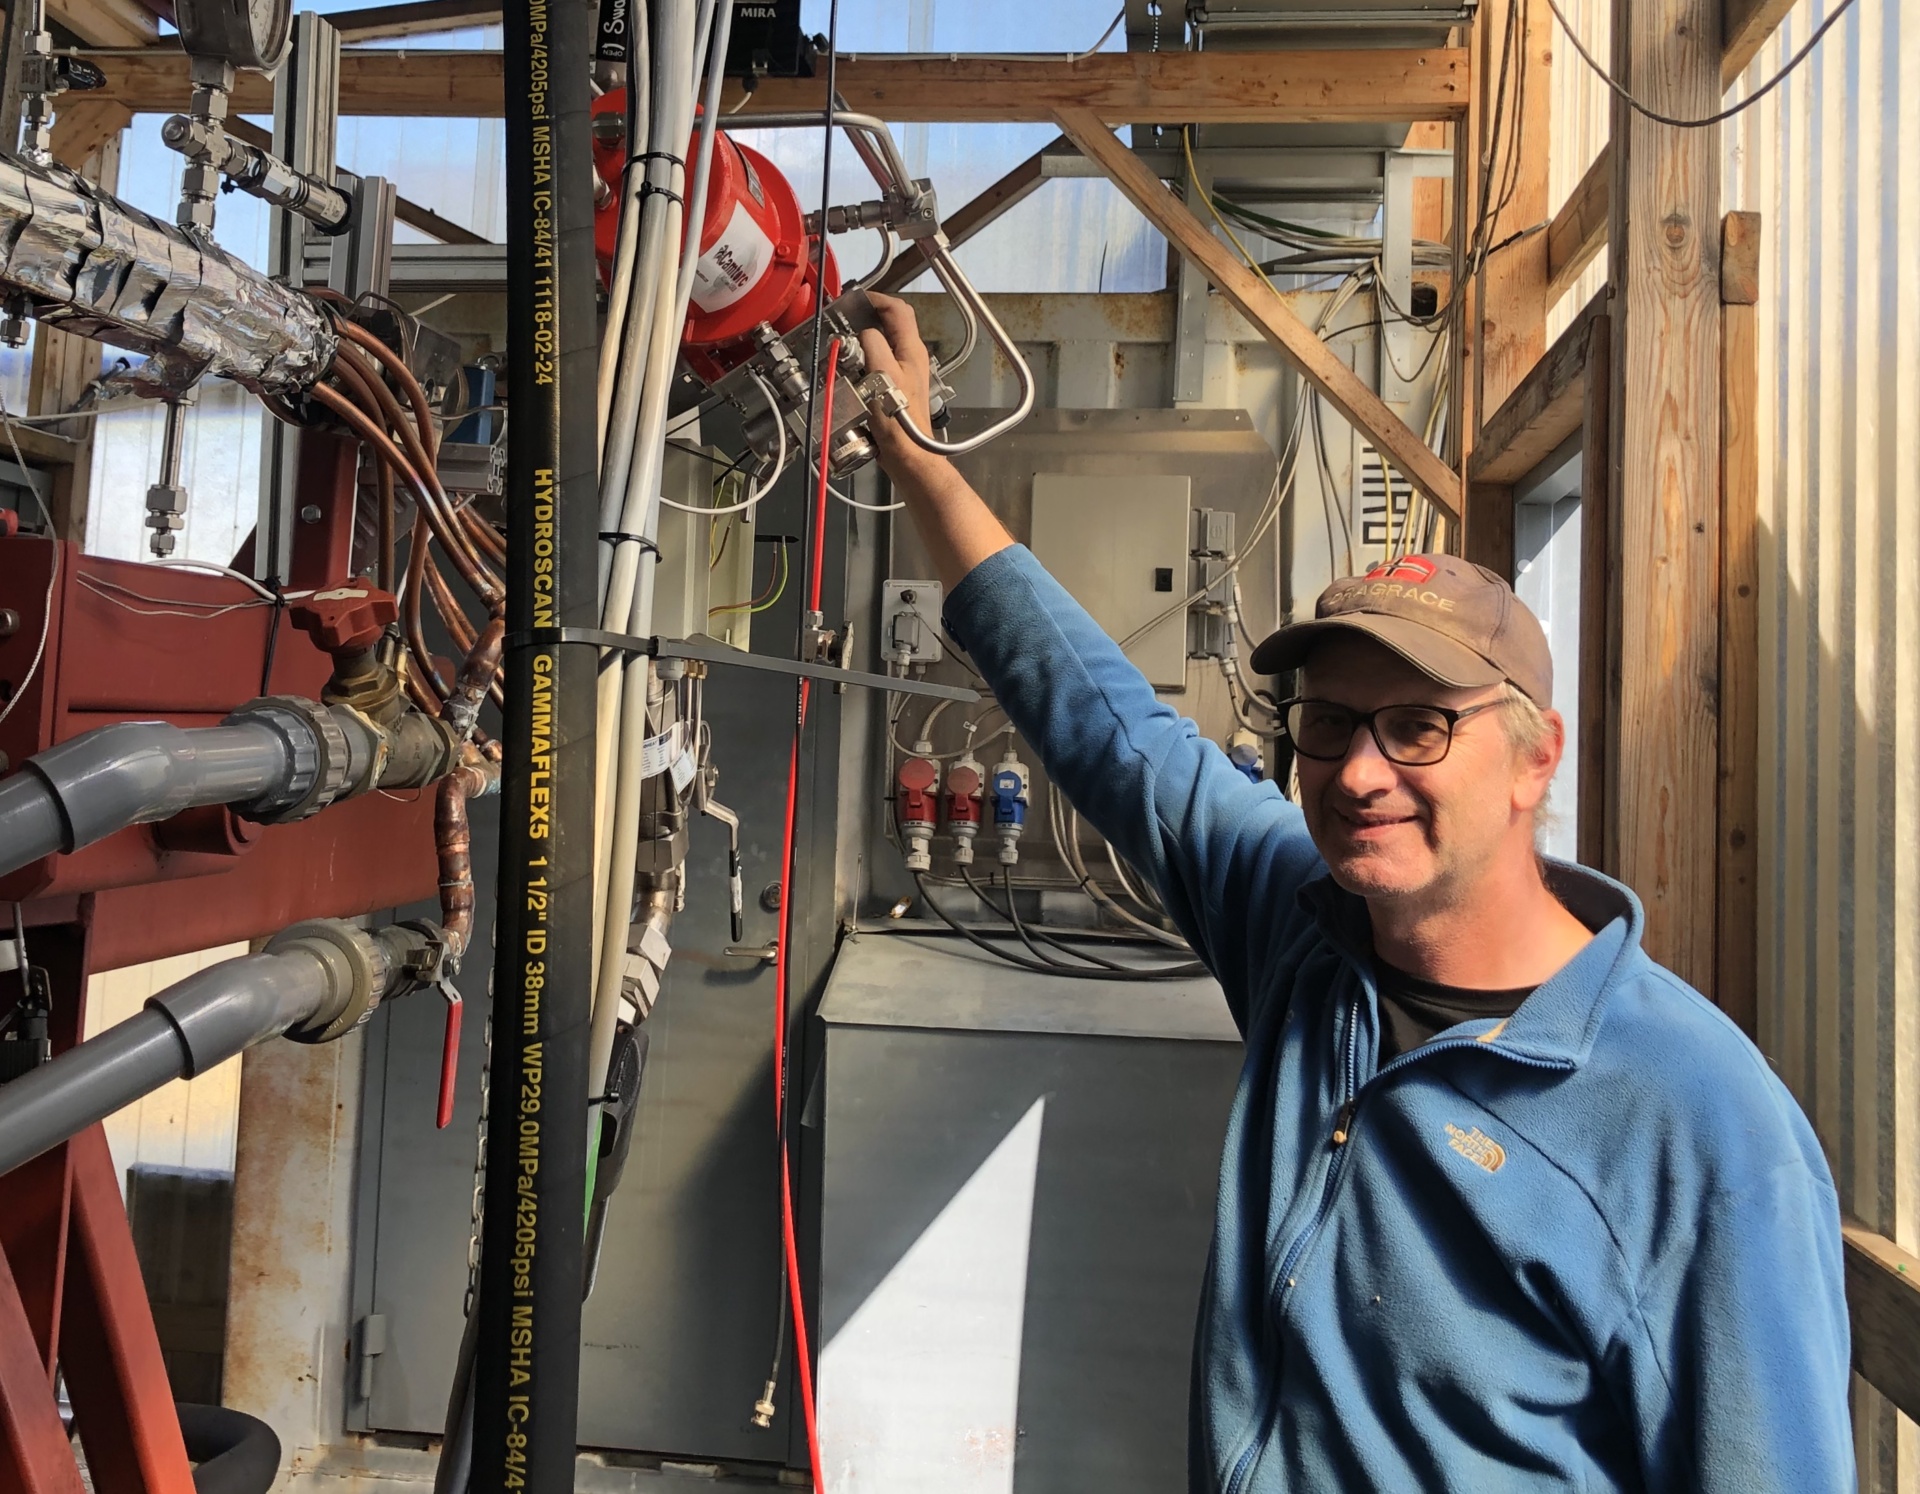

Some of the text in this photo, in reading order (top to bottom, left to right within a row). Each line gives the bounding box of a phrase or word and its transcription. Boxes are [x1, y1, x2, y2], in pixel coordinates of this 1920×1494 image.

[741, 8, 776, 18] MIRA
[603, 49, 623, 57] OPEN
[533, 126, 551, 185] MSHA
[533, 190, 552, 268] IC-84/41
[534, 276, 553, 386] 1118-02-24
[504, 469, 553, 1494] HYDROSCAN GAMMAFLEX5 1 1/2" ID 38mm WP29,0MPa/4205psi MSHA IC-84/4
[1444, 1121, 1488, 1158] NORTH
[1447, 1138, 1482, 1164] FACE
[1470, 1126, 1495, 1149] THE
